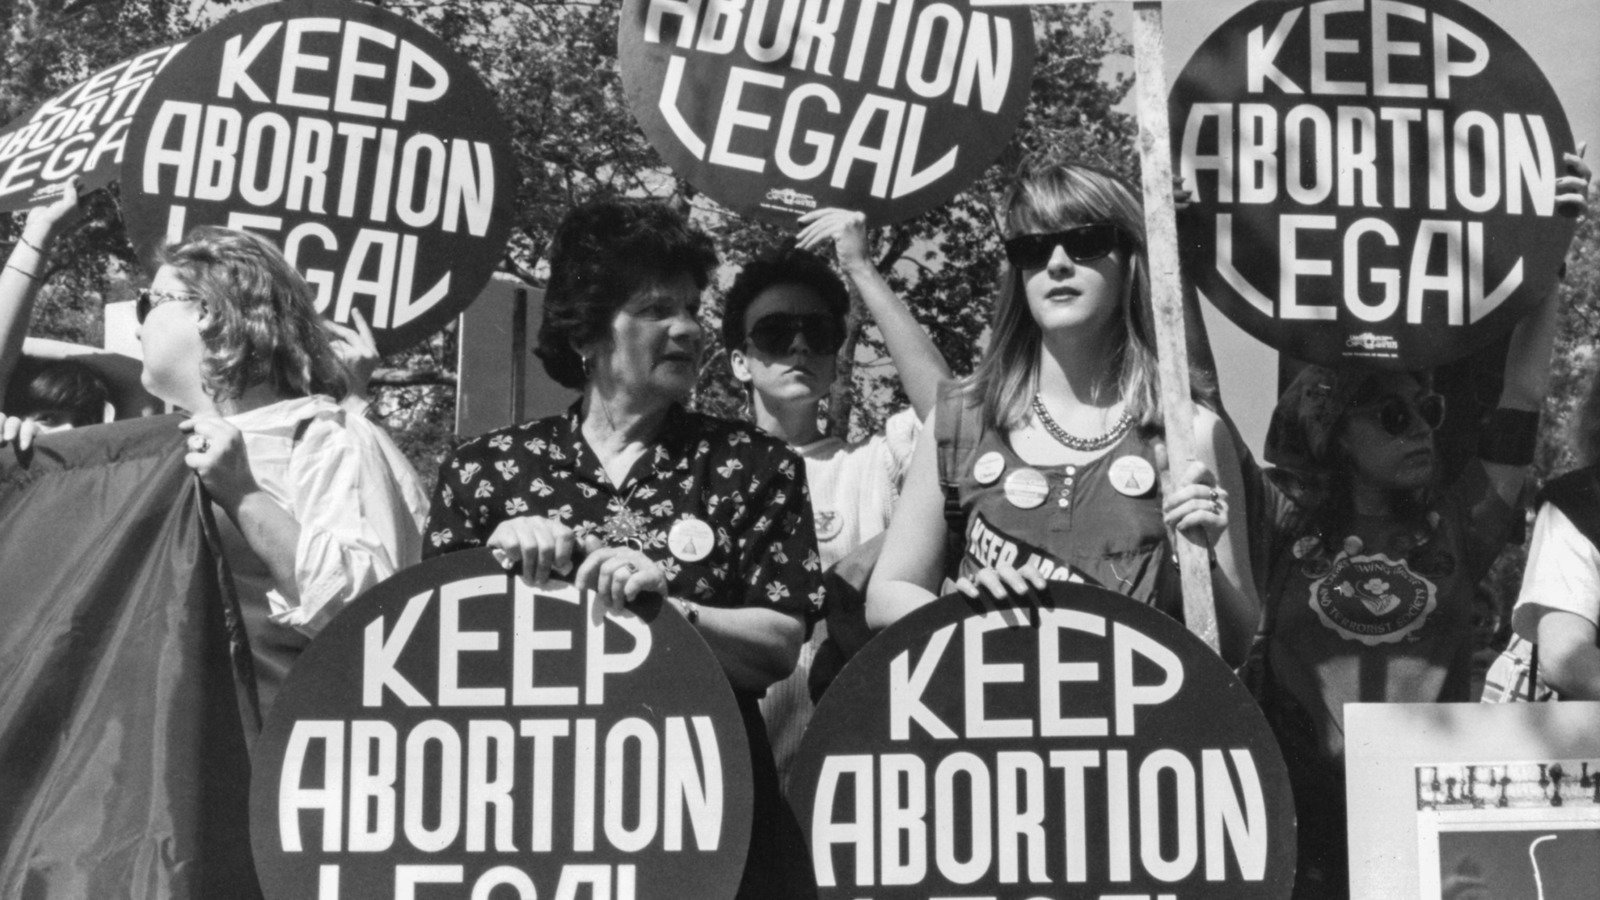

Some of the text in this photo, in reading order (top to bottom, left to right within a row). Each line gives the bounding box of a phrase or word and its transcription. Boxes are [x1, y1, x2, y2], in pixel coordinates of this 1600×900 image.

[217, 17, 450, 121] KEEP
[1247, 0, 1490, 99] KEEP
[0, 76, 155, 163] BORTI
[0, 116, 133, 197] EGA
[143, 99, 495, 237] ABORTION
[658, 54, 959, 200] LEGAL
[1180, 102, 1557, 217] ABORTION
[165, 204, 452, 329] GAL
[1215, 212, 1524, 326] LEGAL
[362, 574, 653, 708] KEEP
[890, 606, 1184, 741] KEEP
[278, 716, 724, 852] ABORTION
[812, 748, 1268, 887] ABORTION
